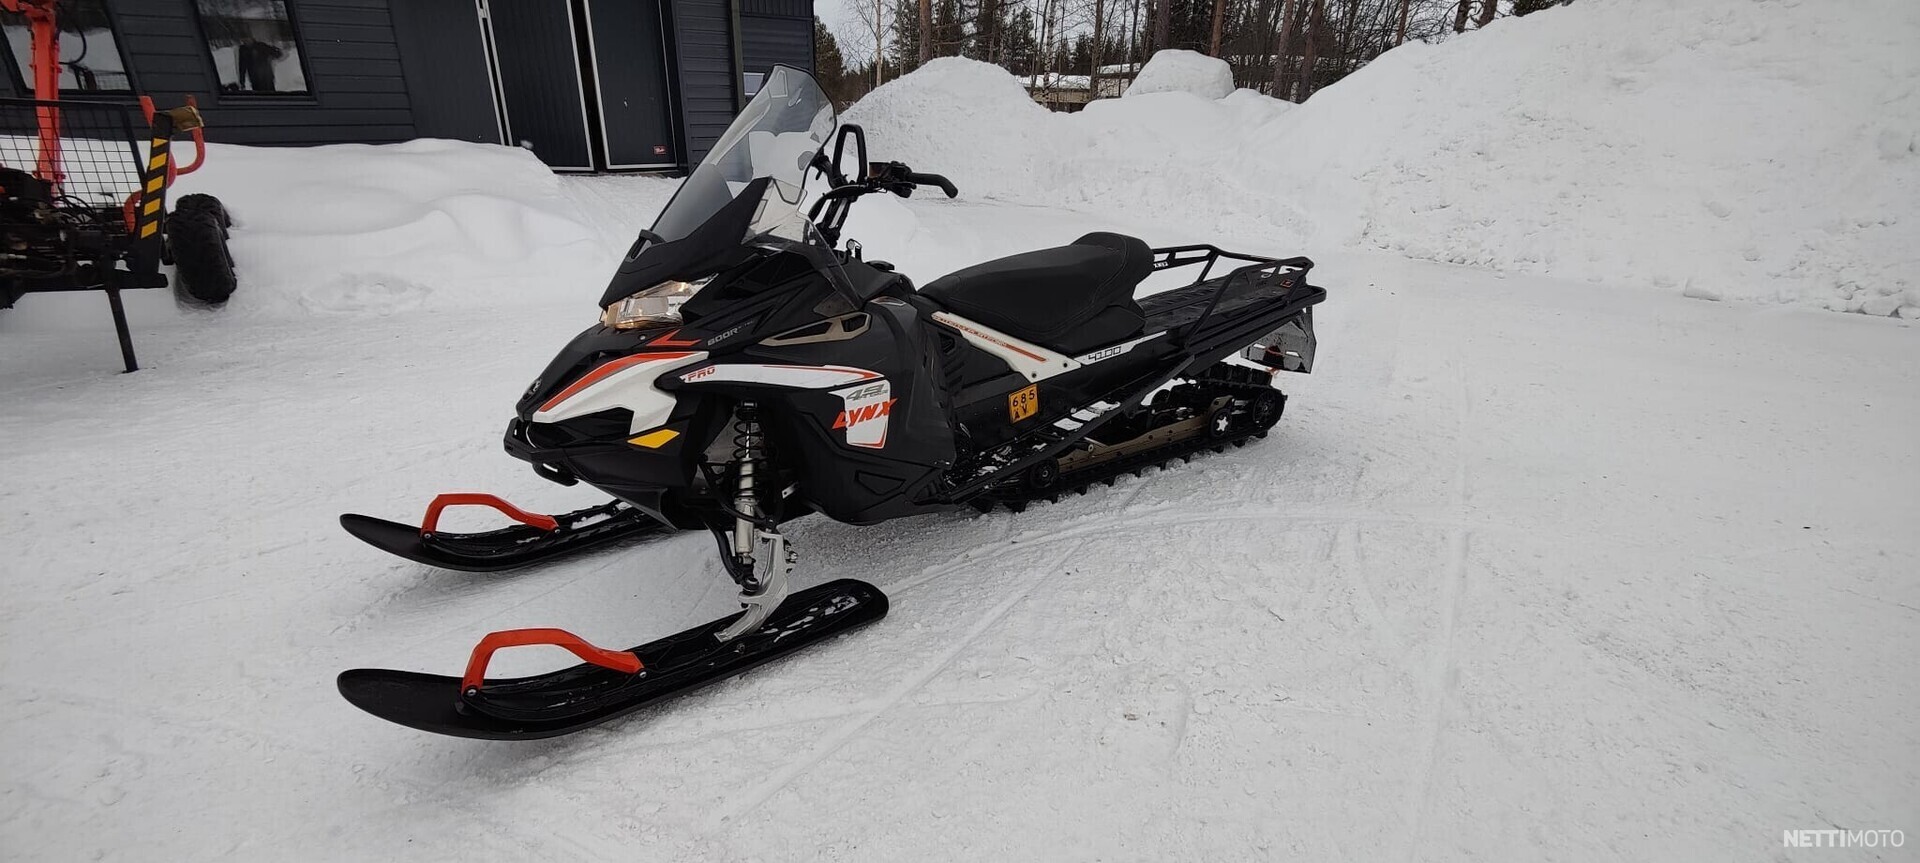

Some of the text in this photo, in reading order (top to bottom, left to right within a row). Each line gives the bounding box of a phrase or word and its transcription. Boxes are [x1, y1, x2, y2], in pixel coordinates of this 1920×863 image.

[687, 366, 715, 381] PRO
[1013, 390, 1035, 407] 685
[832, 398, 898, 429] LYNX
